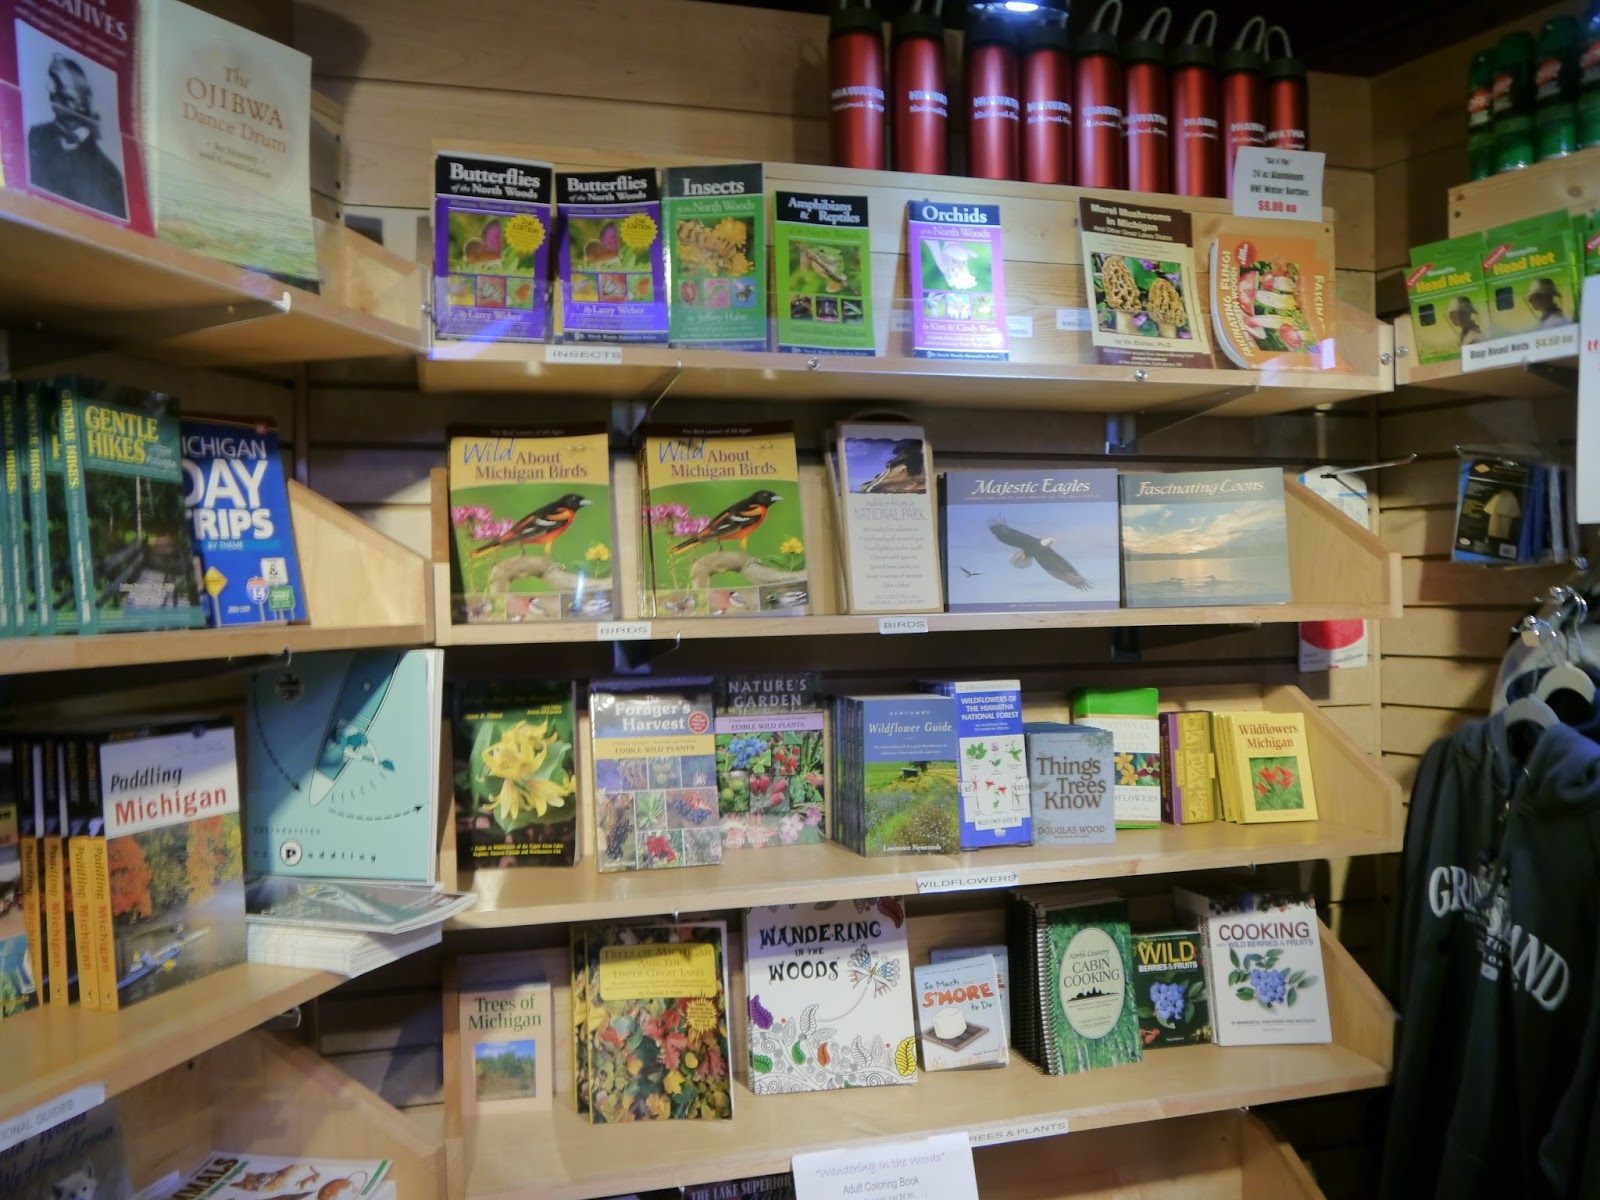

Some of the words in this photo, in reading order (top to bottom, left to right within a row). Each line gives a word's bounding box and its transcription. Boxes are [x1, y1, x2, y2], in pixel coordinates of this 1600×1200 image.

[223, 65, 249, 89] The
[186, 77, 283, 130] OJIBWA
[182, 101, 236, 136] Dance
[240, 123, 287, 153] Drum
[449, 161, 541, 189] Butterflies
[566, 174, 648, 194] Butterflies
[471, 182, 503, 196] North
[504, 186, 539, 199] Woods
[682, 177, 745, 196] Insects
[587, 191, 616, 202] North
[616, 190, 648, 201] Woods
[788, 196, 853, 213] Amphibians
[693, 203, 722, 214] North
[722, 201, 756, 212] Woods
[922, 205, 988, 224] Orchids
[1090, 203, 1118, 215] Morel
[1118, 207, 1172, 222] Mushrooms
[800, 211, 810, 219] &
[818, 210, 861, 225] Reptiles
[1117, 218, 1159, 232] Michigan
[933, 227, 960, 237] North
[961, 228, 991, 238] Woods
[1221, 250, 1231, 291] FUNGI
[1493, 256, 1527, 275] Head
[1529, 252, 1556, 268] Net
[1416, 275, 1448, 294] Head
[1448, 271, 1473, 287] Net
[594, 303, 616, 316] Larry
[617, 302, 647, 314] Weber
[930, 322, 947, 331] Kim
[552, 349, 623, 361] INSECTS
[85, 405, 159, 444] GENTLE
[88, 430, 146, 465] HIKES
[181, 435, 268, 461] ICHIGAN
[463, 437, 517, 466] Wild
[658, 437, 708, 465] Wild
[707, 450, 751, 463] About
[66, 444, 80, 490] HIKES
[515, 451, 562, 465] About
[475, 465, 545, 482] Michigan
[549, 464, 588, 478] Birds
[671, 464, 736, 480] Michigan
[739, 462, 777, 476] Birds
[181, 456, 269, 510] DAY
[972, 479, 1039, 496] Majestic
[1042, 478, 1091, 495] Eagles
[1136, 480, 1220, 498] Fascinating
[1219, 478, 1265, 493] Loons
[854, 507, 900, 521] NATIONAL
[901, 507, 928, 521] PARK
[600, 626, 648, 636] BIRDS
[884, 620, 925, 629] BIRDS
[727, 678, 808, 694] NATURE'S
[645, 694, 661, 704] The
[733, 693, 803, 709] GARDEN
[960, 695, 1008, 705] WILDFLOWERS
[1008, 695, 1018, 703] OF
[980, 703, 1015, 712] HIAWATHA
[615, 700, 691, 718] Forager's
[961, 712, 996, 721] NATIONAL
[996, 711, 1019, 720] FOREST
[622, 717, 687, 732] Harvest
[731, 723, 757, 731] EDIBLE
[758, 722, 777, 730] WILD
[778, 721, 806, 729] PLANTS
[868, 721, 921, 737] Wildflower
[924, 721, 953, 733] Guide
[1238, 723, 1299, 736] Wildflowers
[1247, 737, 1294, 751] Michigan
[1036, 756, 1101, 781] Things
[110, 763, 183, 793] Paddling
[1056, 777, 1106, 795] Trees
[114, 787, 227, 828] Michigan
[1044, 791, 1102, 810] Know
[1037, 826, 1076, 835] DOUGLAS
[1079, 825, 1106, 834] WOOD
[883, 843, 911, 851] Lawrence
[912, 843, 942, 851] Newcomb
[918, 875, 1017, 889] WILDFLOWERS
[759, 920, 882, 950] WANDERING
[1218, 921, 1310, 941] COOKING
[1137, 940, 1196, 965] WILD
[1227, 940, 1246, 949] WILD
[1247, 940, 1279, 948] BERRIES
[1286, 938, 1314, 946] FRUITS
[1070, 950, 1087, 960] North
[1088, 949, 1111, 959] Country
[768, 957, 840, 985] WOODS
[1072, 958, 1110, 975] CABIN
[1138, 963, 1168, 973] BERRIES
[1168, 962, 1174, 971] &
[1174, 961, 1198, 970] FRUITS
[924, 981, 934, 990] So
[936, 978, 960, 989] Much
[1063, 968, 1120, 988] COOKING
[474, 996, 511, 1013] Trees
[513, 993, 536, 1011] of
[922, 981, 995, 1009] S'MORE
[970, 1003, 979, 1011] to
[980, 1001, 993, 1010] Do
[468, 1011, 542, 1032] Michigan
[36, 1099, 74, 1125] GUIDES
[969, 1132, 1004, 1143] REES
[1017, 1122, 1066, 1136] PLANTS
[894, 1158, 908, 1168] the
[713, 1184, 740, 1200] LAKE
[740, 1175, 793, 1196] SUPERIOR
[843, 1184, 863, 1196] Adult
[864, 1180, 899, 1195] Coloring
[899, 1176, 920, 1188] Book
